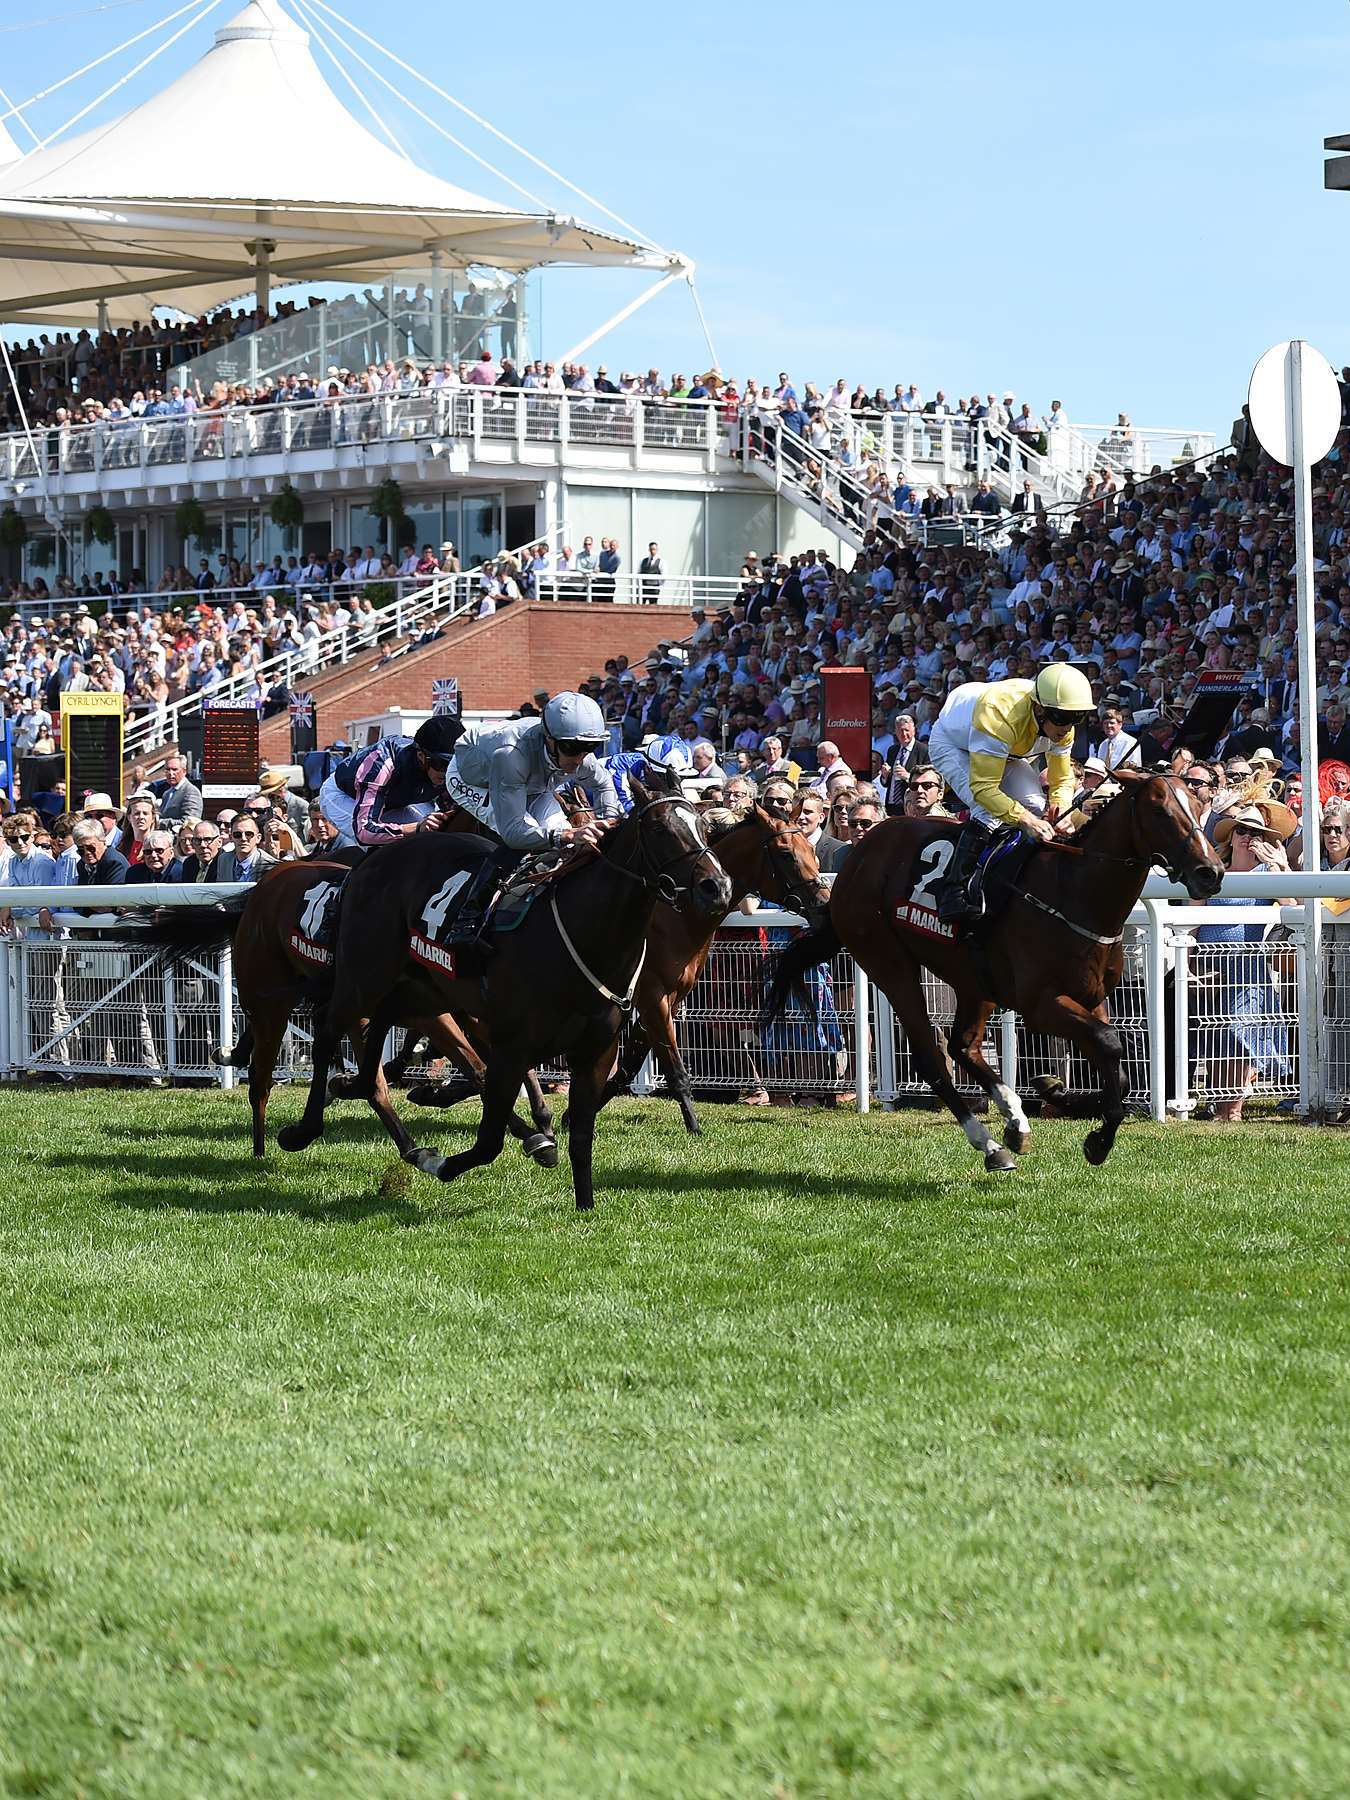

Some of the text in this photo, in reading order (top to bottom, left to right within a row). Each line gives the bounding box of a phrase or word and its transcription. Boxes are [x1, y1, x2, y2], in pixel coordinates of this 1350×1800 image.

[66, 696, 117, 706] CYRIL LYNCH
[208, 700, 256, 709] FORECASTS
[826, 718, 867, 728] Ladbrokes
[450, 776, 483, 804] Clipper
[909, 839, 955, 911] 2
[421, 870, 471, 941] 4
[909, 907, 954, 938] MARKEL
[298, 938, 328, 963] MARK
[417, 938, 453, 972] MARKEL
